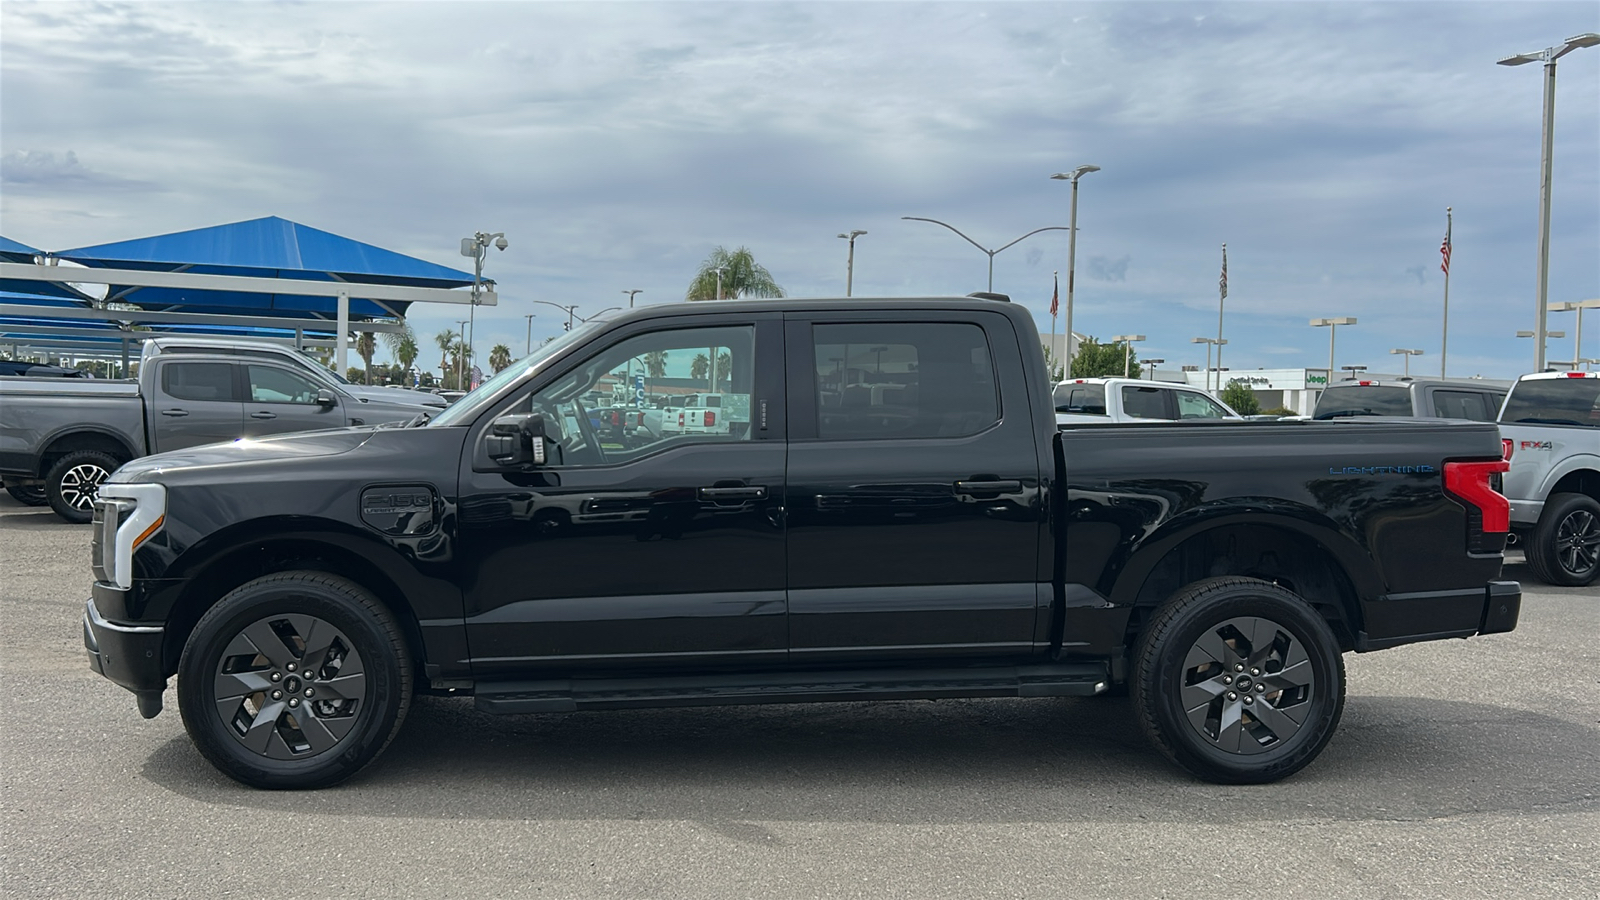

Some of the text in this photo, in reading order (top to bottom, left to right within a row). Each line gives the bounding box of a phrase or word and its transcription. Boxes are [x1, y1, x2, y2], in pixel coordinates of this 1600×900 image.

[1251, 376, 1269, 384] Service
[1306, 374, 1327, 385] Jeep
[1520, 440, 1553, 451] FX4
[1329, 464, 1435, 475] LIGHTNING
[364, 494, 430, 508] F-150
